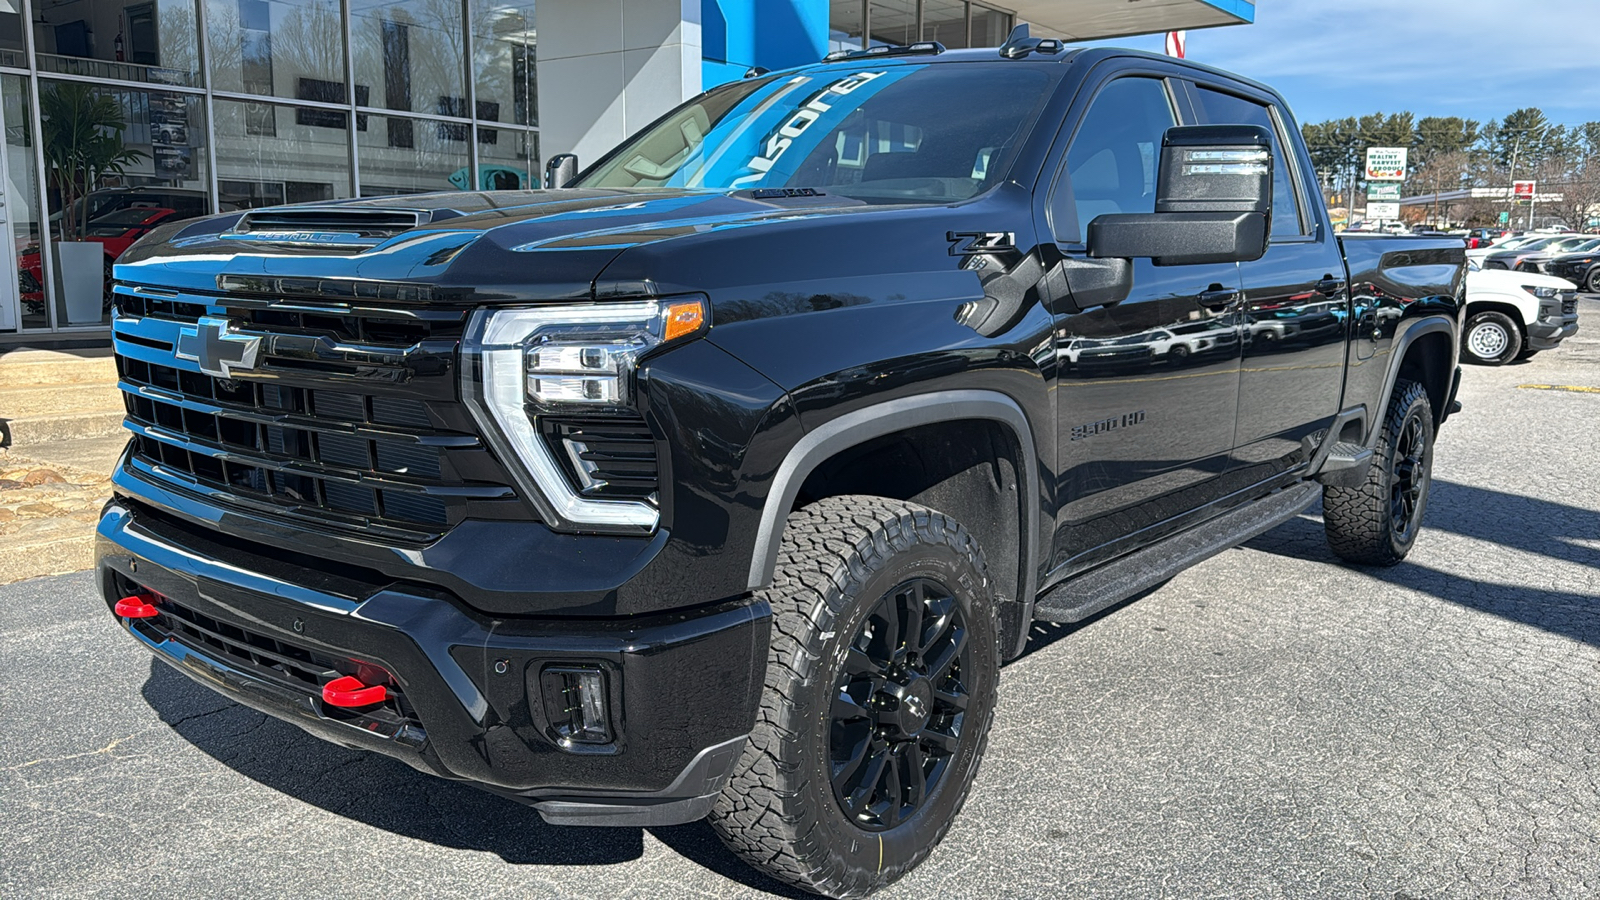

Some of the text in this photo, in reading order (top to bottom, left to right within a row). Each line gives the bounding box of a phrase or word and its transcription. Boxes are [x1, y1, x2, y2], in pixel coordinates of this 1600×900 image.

[255, 232, 341, 241] CHEVROLET
[946, 231, 1015, 256] Z71
[1122, 410, 1146, 427] HD
